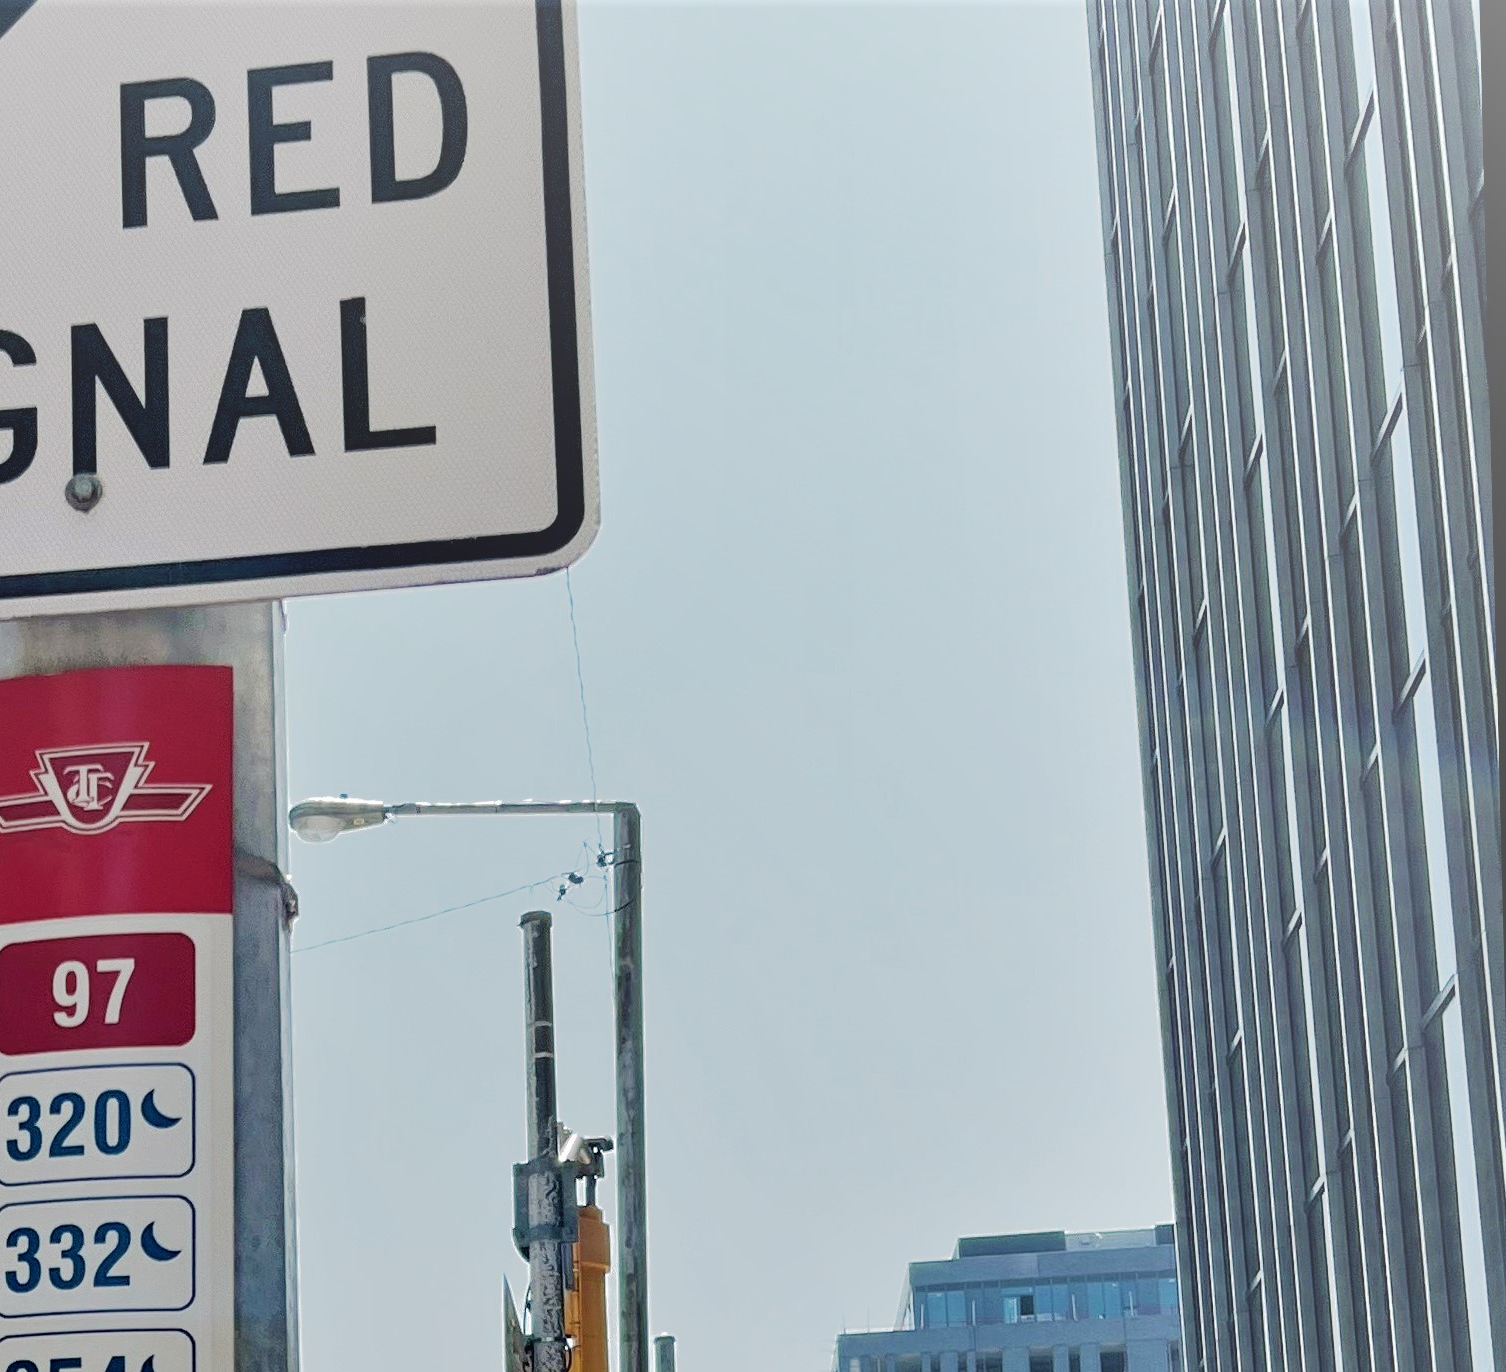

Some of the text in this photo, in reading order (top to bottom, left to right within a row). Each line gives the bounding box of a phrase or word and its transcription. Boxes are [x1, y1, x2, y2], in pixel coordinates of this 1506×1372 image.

[119, 51, 469, 228] RED
[52, 958, 135, 1028] 97
[6, 1089, 132, 1162] 320
[5, 1221, 131, 1293] 332
